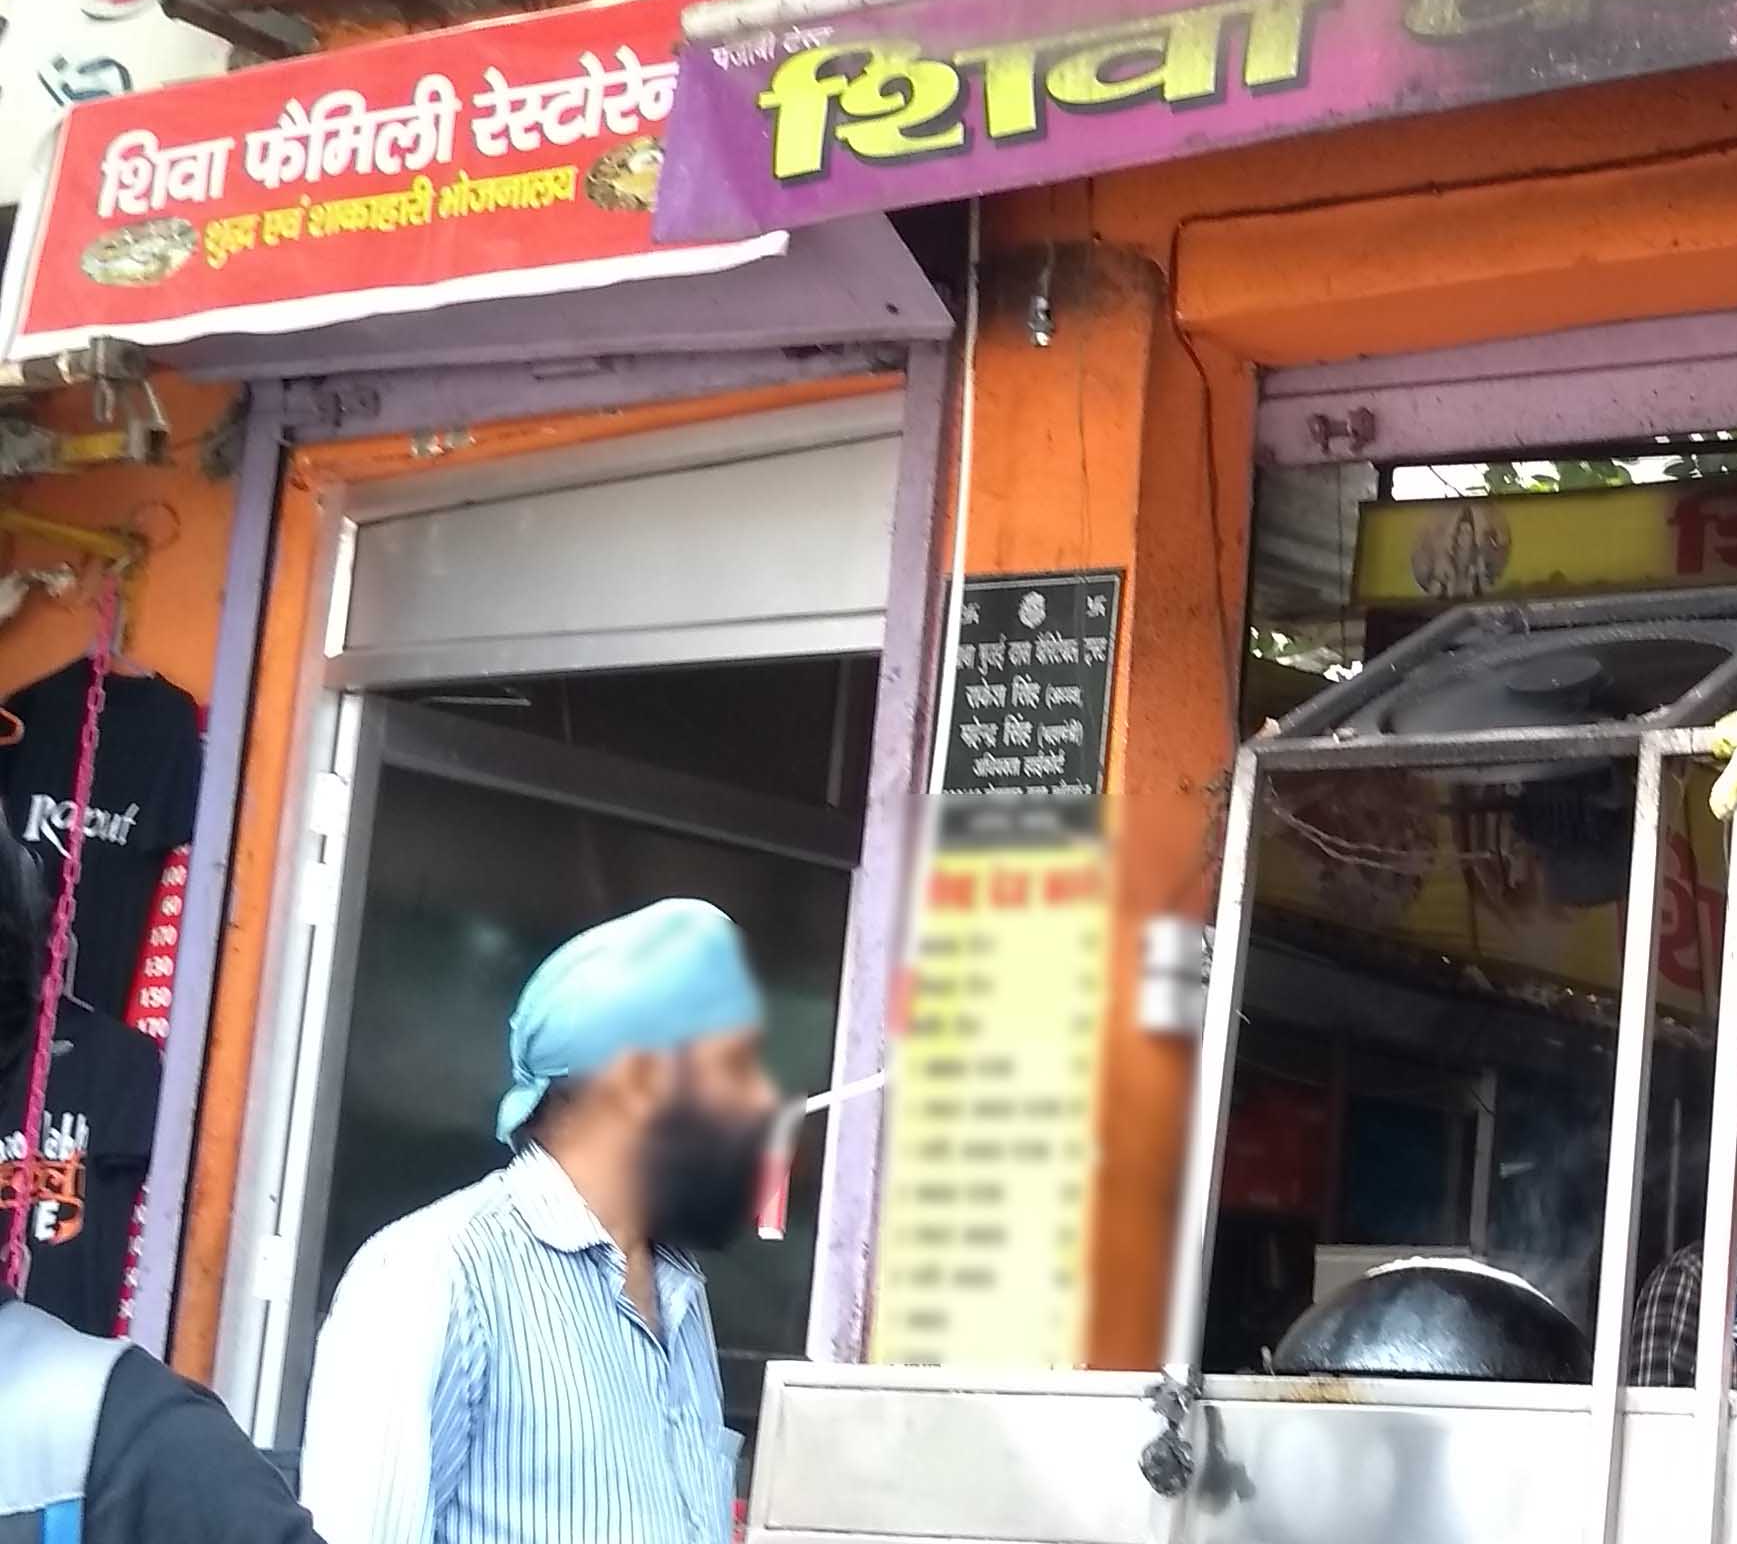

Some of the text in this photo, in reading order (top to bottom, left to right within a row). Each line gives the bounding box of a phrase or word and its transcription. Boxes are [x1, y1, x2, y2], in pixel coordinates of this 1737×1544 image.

[98, 129, 235, 218] शिवा
[245, 73, 463, 189] फैमिली
[437, 165, 578, 219] भोजनालय
